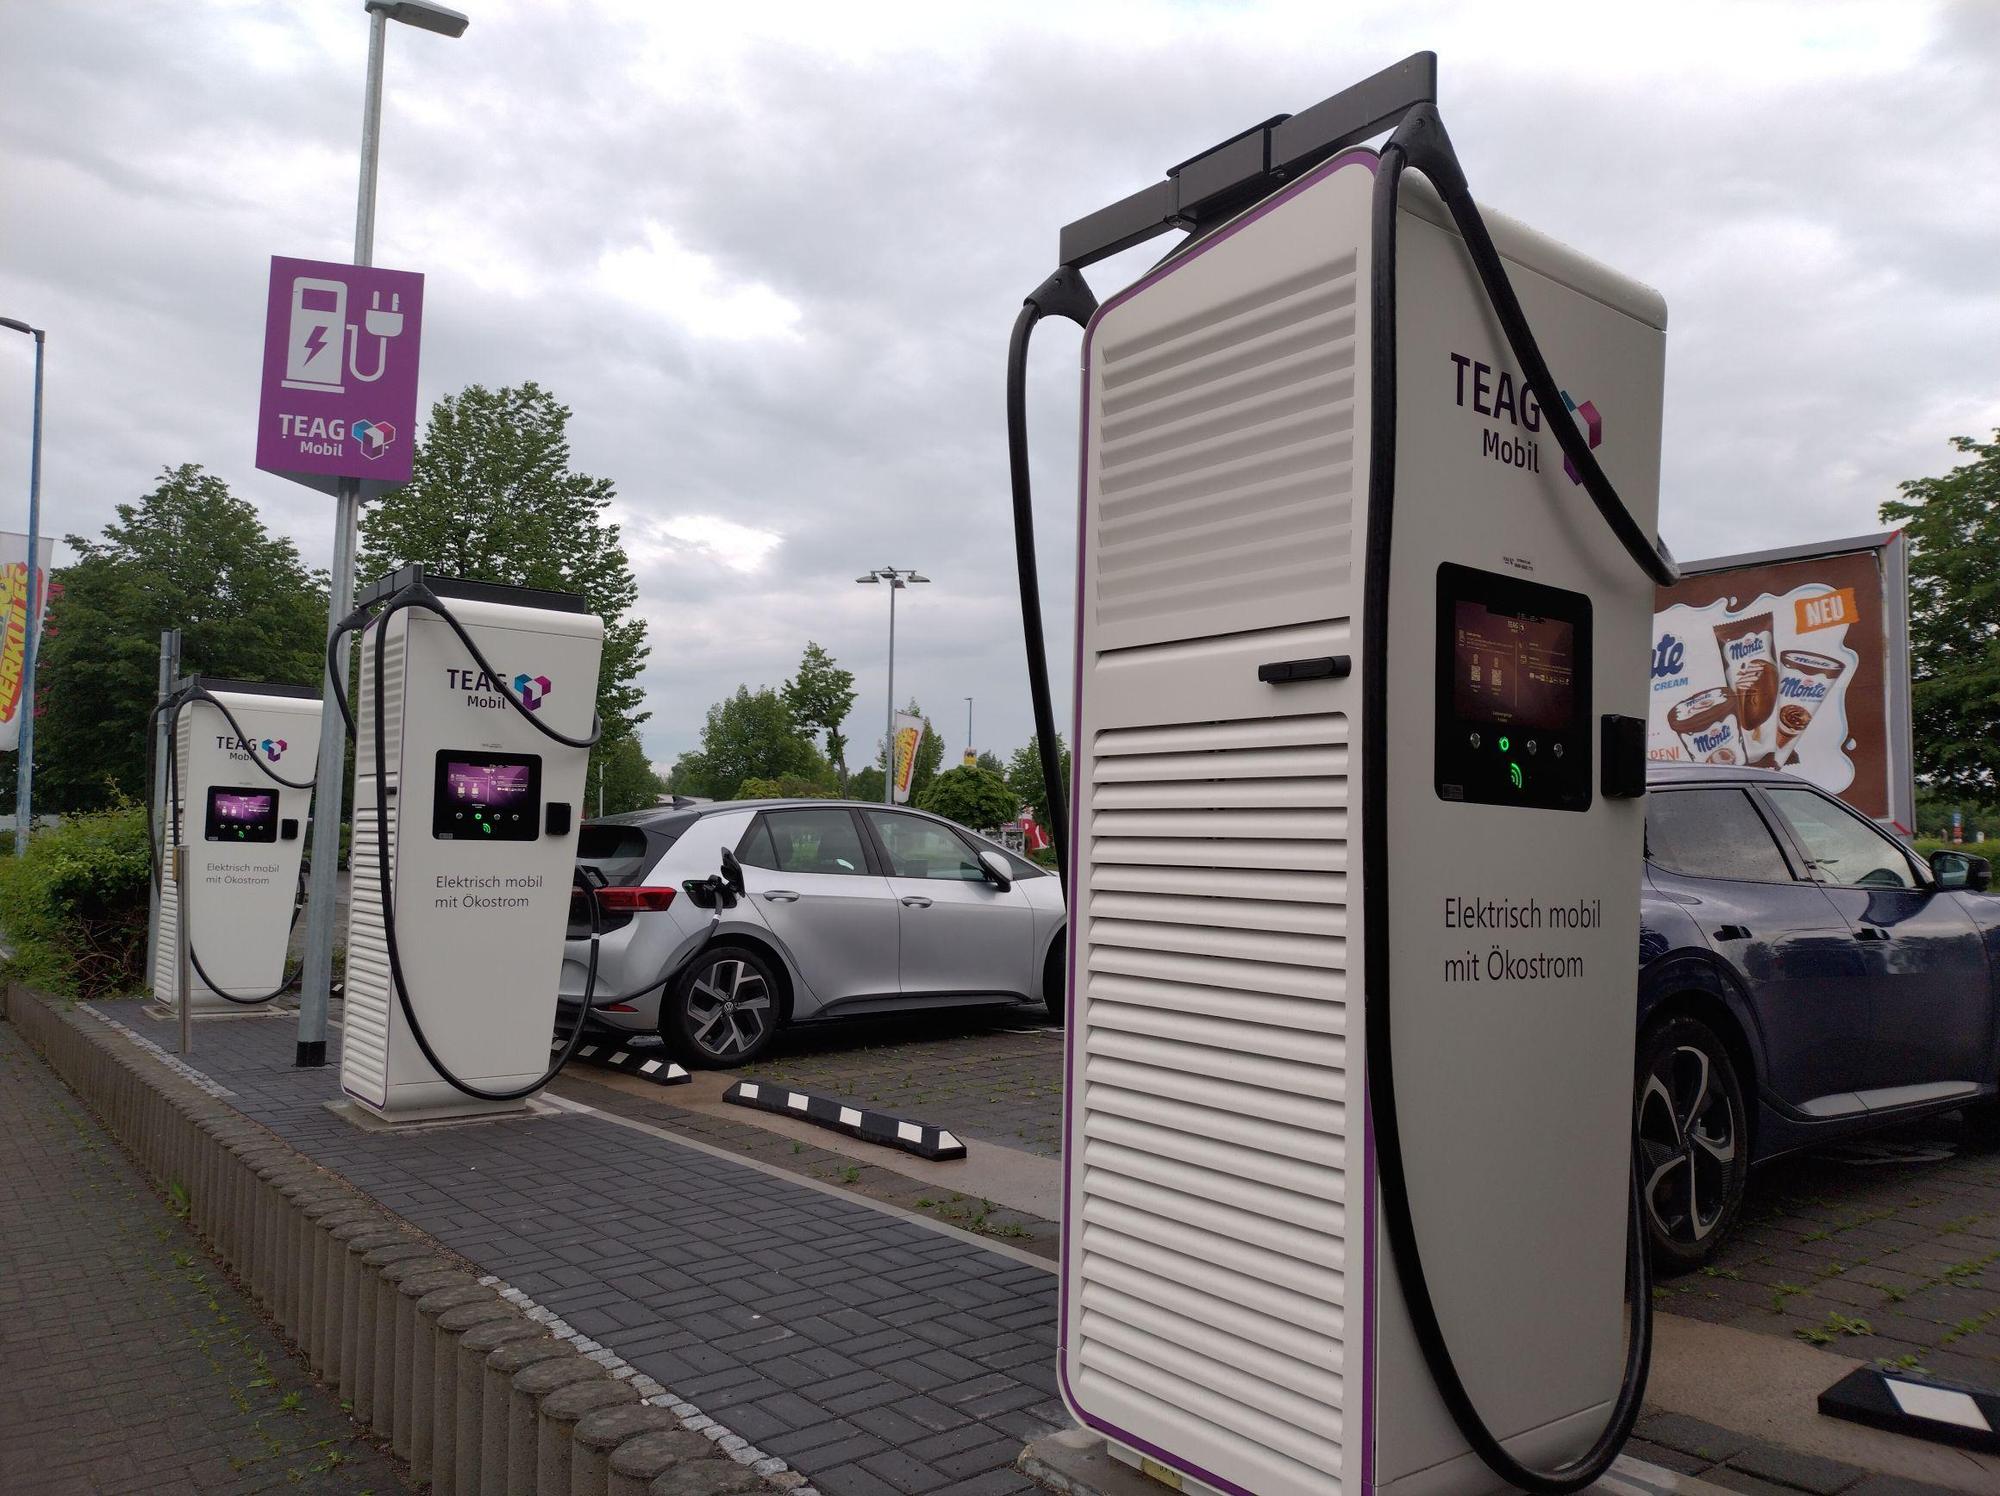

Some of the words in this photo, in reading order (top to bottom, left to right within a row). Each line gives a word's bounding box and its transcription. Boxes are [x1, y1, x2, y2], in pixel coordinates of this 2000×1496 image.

[1450, 352, 1541, 432] TEAG
[278, 413, 345, 441] TEAG
[300, 440, 343, 457] Mobil
[1482, 428, 1540, 473] Mobil
[1804, 595, 1845, 628] NEU
[1729, 638, 1763, 660] Monte
[1654, 677, 1689, 692] CREAM
[1780, 677, 1826, 698] Monte
[467, 695, 506, 709] Mobil
[1693, 725, 1733, 753] Monte
[207, 863, 250, 873] Elektrisch
[253, 863, 279, 873] mobil
[206, 875, 221, 885] mit
[435, 875, 500, 889] Elektrisch
[505, 875, 544, 889] mobil
[435, 896, 458, 909] mit
[462, 893, 529, 909] Ökostrom
[1445, 896, 1541, 929] Elektrisch
[1549, 898, 1601, 929] mobil
[1445, 950, 1480, 982] mit
[1487, 944, 1584, 981] Ökostrom
